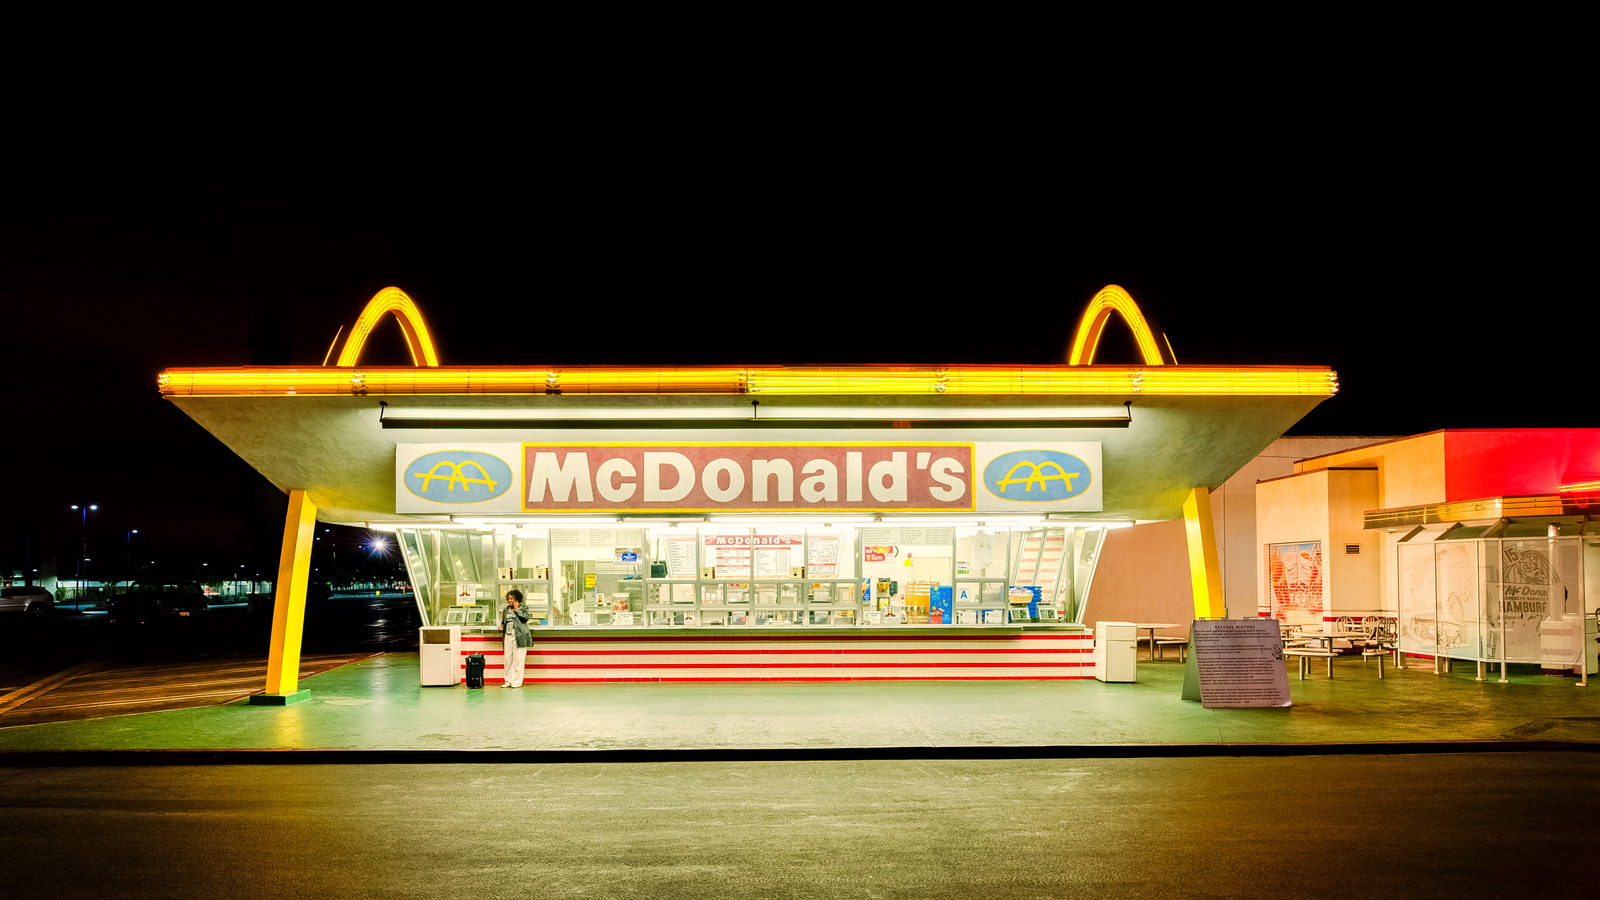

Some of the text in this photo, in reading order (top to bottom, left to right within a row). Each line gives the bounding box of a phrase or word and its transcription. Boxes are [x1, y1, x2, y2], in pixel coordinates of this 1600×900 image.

[528, 451, 966, 503] McDonald's
[716, 536, 791, 545] McDonald's
[1504, 547, 1519, 562] 15
[960, 590, 968, 599] A
[1505, 585, 1550, 597] McDonal
